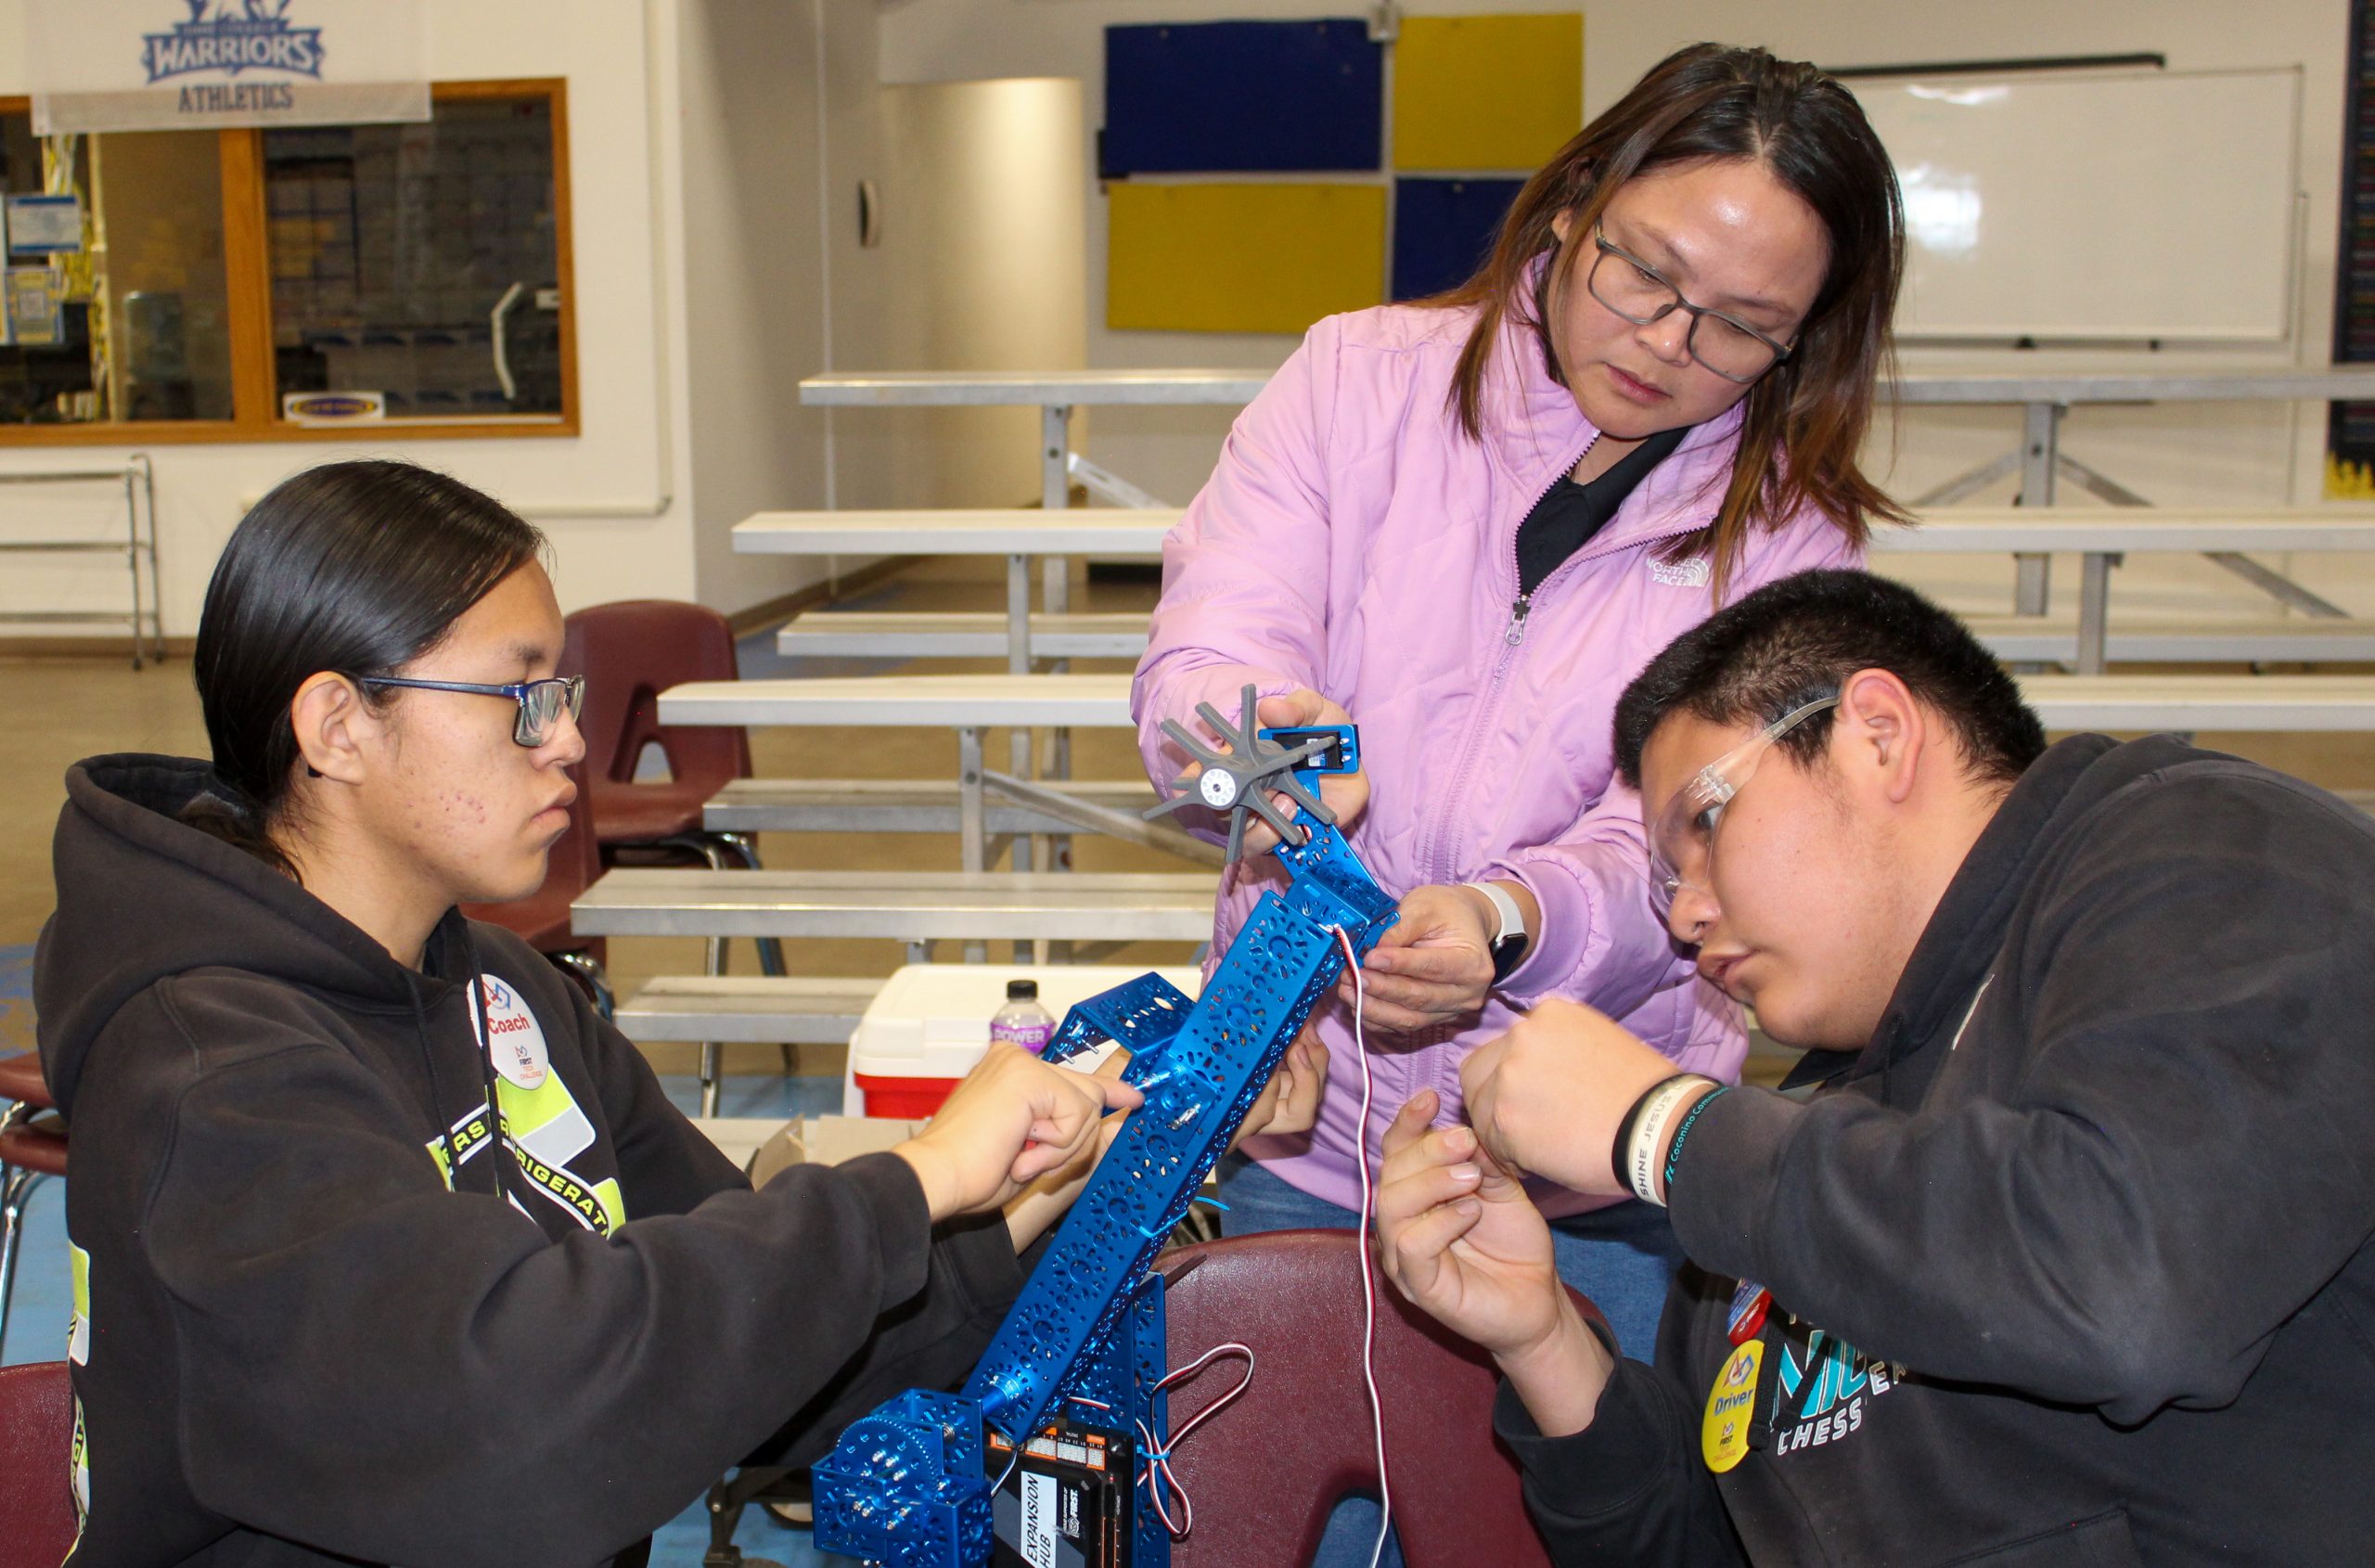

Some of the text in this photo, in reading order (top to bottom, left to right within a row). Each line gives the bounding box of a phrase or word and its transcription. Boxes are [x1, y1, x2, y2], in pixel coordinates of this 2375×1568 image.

[152, 32, 314, 76] WARRIORS
[178, 83, 294, 112] ATHLETICS
[1652, 573, 1688, 586] FACE
[487, 1013, 531, 1035] Coach
[995, 1029, 1045, 1044] POWER
[1637, 1096, 1672, 1196] SHINE JESUS
[1670, 1115, 1696, 1162] Coconino
[1714, 1388, 1753, 1416] Driver
[1777, 1397, 1862, 1456] CHESS
[1027, 1473, 1038, 1562] EXPANSION
[1040, 1534, 1051, 1568] HUB
